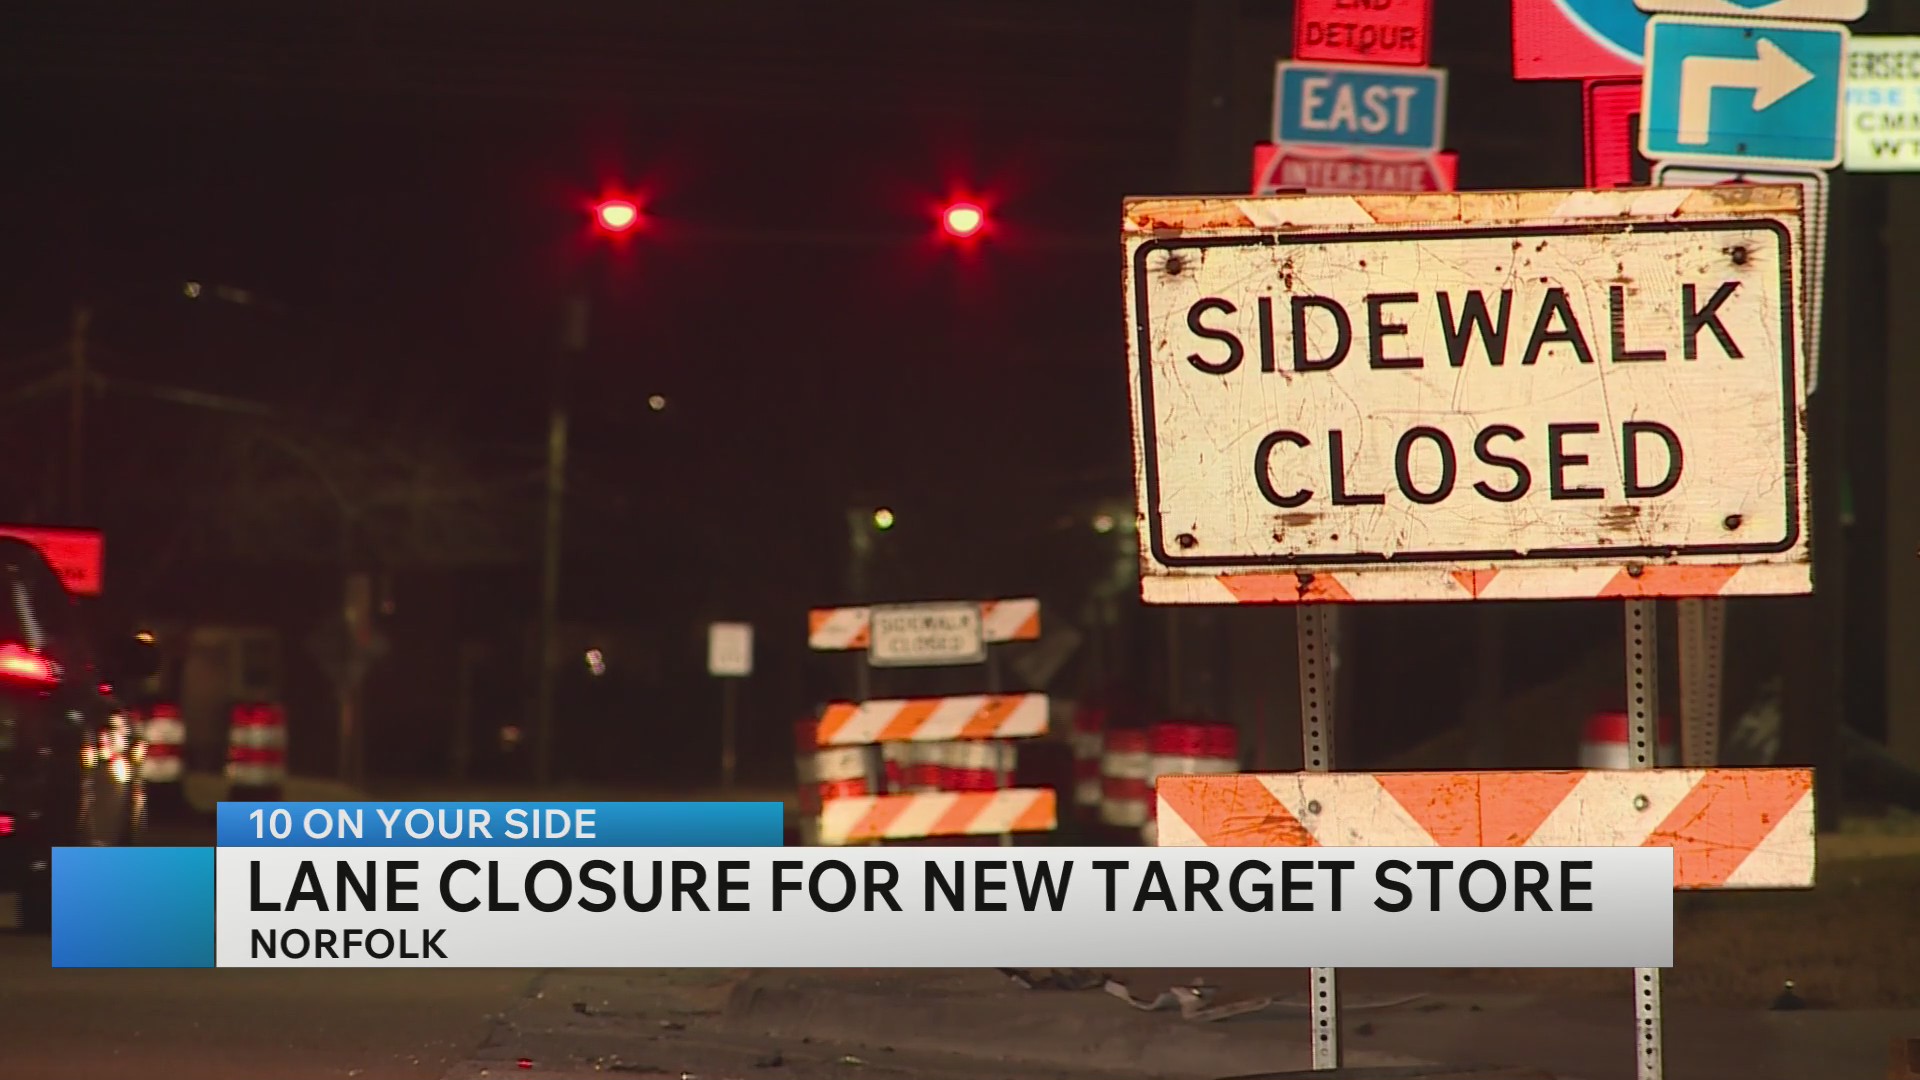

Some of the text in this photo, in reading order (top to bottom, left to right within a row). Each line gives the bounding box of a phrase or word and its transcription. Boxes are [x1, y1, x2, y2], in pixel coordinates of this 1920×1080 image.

[1306, 22, 1416, 50] DETOUR
[1301, 77, 1418, 135] EAST
[1186, 281, 1745, 374] SIDEWALK
[1253, 421, 1683, 508] CLOSED
